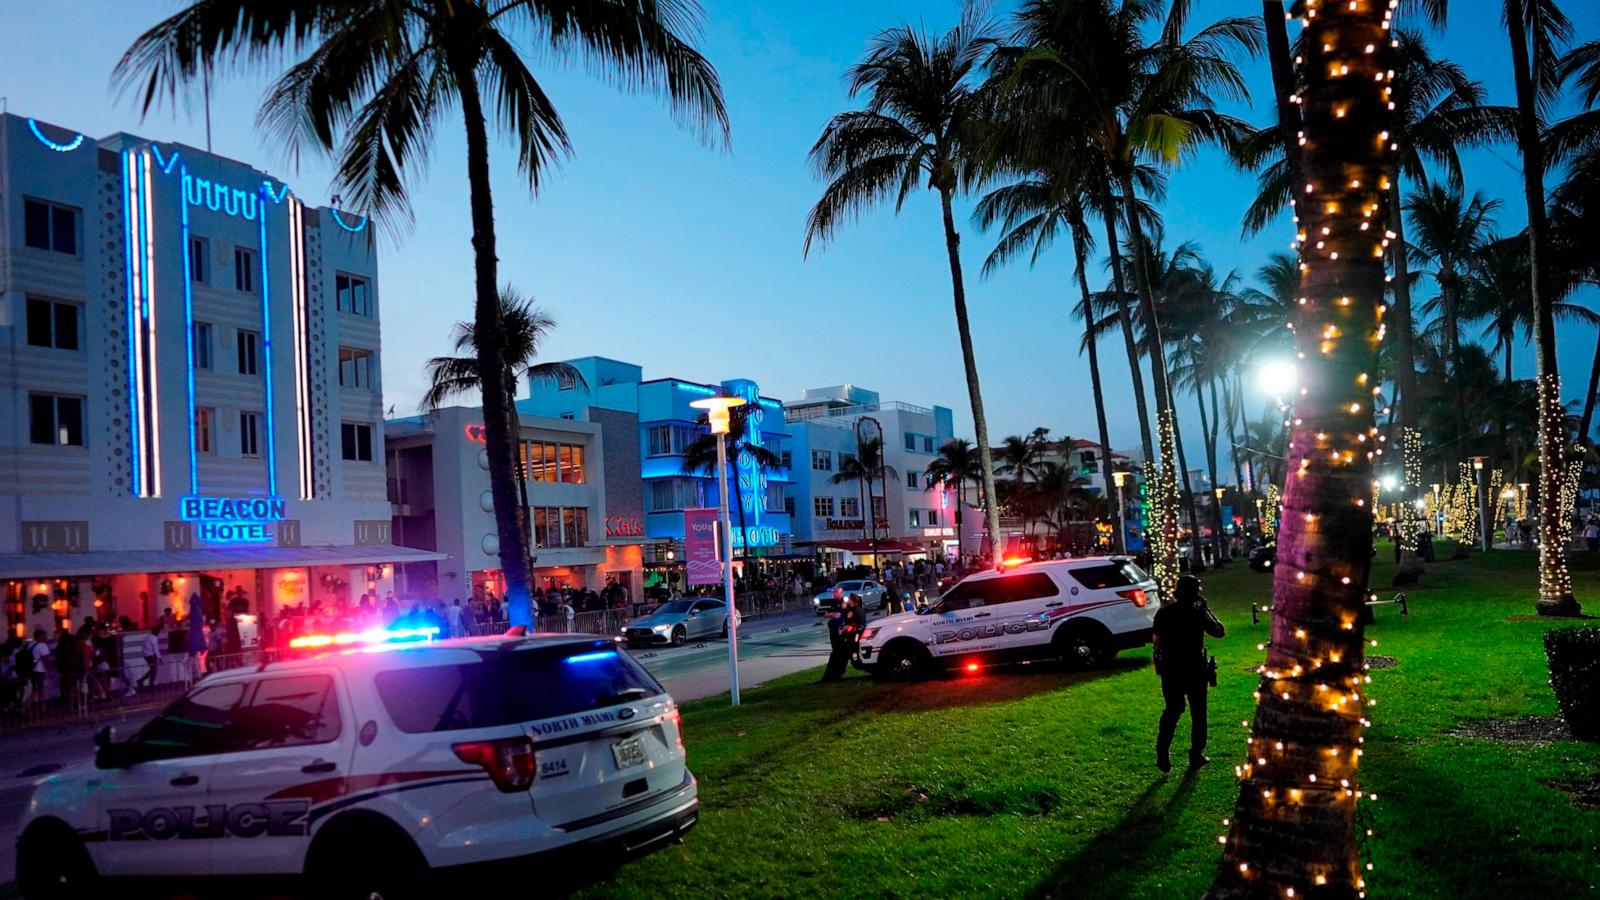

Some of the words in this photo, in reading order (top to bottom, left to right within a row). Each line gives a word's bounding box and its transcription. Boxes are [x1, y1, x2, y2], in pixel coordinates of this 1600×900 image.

[184, 498, 287, 520] BEACON
[200, 522, 273, 541] HOTEL
[691, 523, 713, 532] YOUR
[934, 620, 1050, 644] POLICE
[531, 718, 579, 736] NORTH
[582, 711, 614, 727] MIAMI
[541, 758, 567, 774] 8414
[108, 800, 311, 841] POLICE
